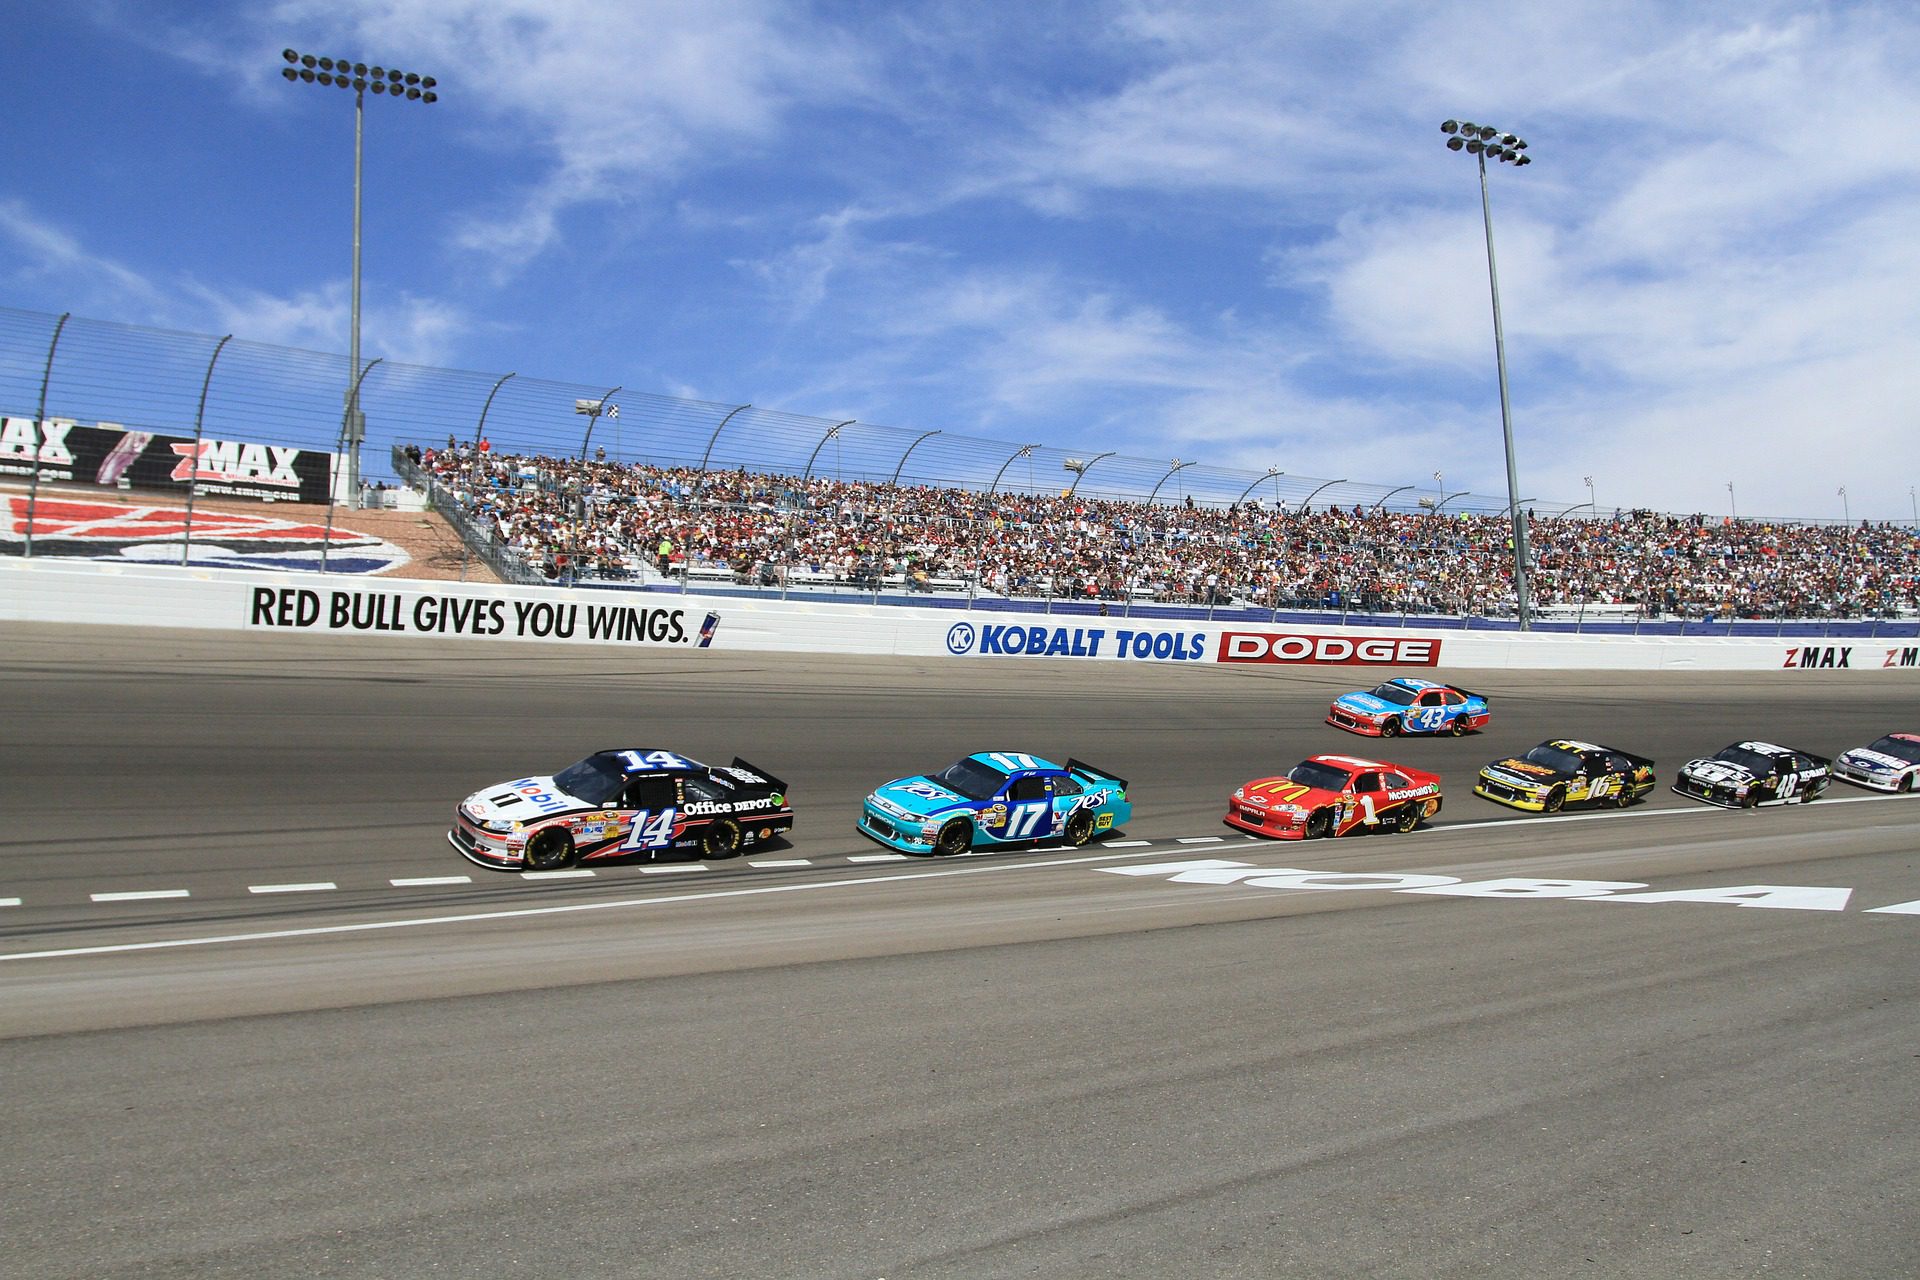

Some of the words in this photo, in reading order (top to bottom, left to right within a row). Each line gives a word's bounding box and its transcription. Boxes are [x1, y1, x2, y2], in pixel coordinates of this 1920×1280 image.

[0, 417, 73, 465] AX
[252, 587, 320, 627] RED
[329, 591, 405, 631] BULL
[413, 596, 505, 635] GIVES
[514, 602, 577, 638] YOU
[587, 605, 689, 643] WINGS.
[979, 625, 1105, 657] KOBALT
[1116, 630, 1206, 660] TOOLS
[1228, 635, 1432, 662] DODGE
[1783, 646, 1853, 668] ZMAX
[1883, 647, 1920, 667] ZM
[1420, 708, 1446, 728] 43
[617, 750, 688, 771] 14
[508, 779, 569, 813] Mobil
[1388, 784, 1432, 800] McDonald's
[1585, 775, 1610, 800] 16
[1775, 773, 1798, 798] 48
[684, 801, 731, 815] Office
[733, 798, 772, 811] DEPOT
[1360, 795, 1380, 825] 1
[619, 807, 676, 850] 14
[1005, 802, 1049, 838] 17
